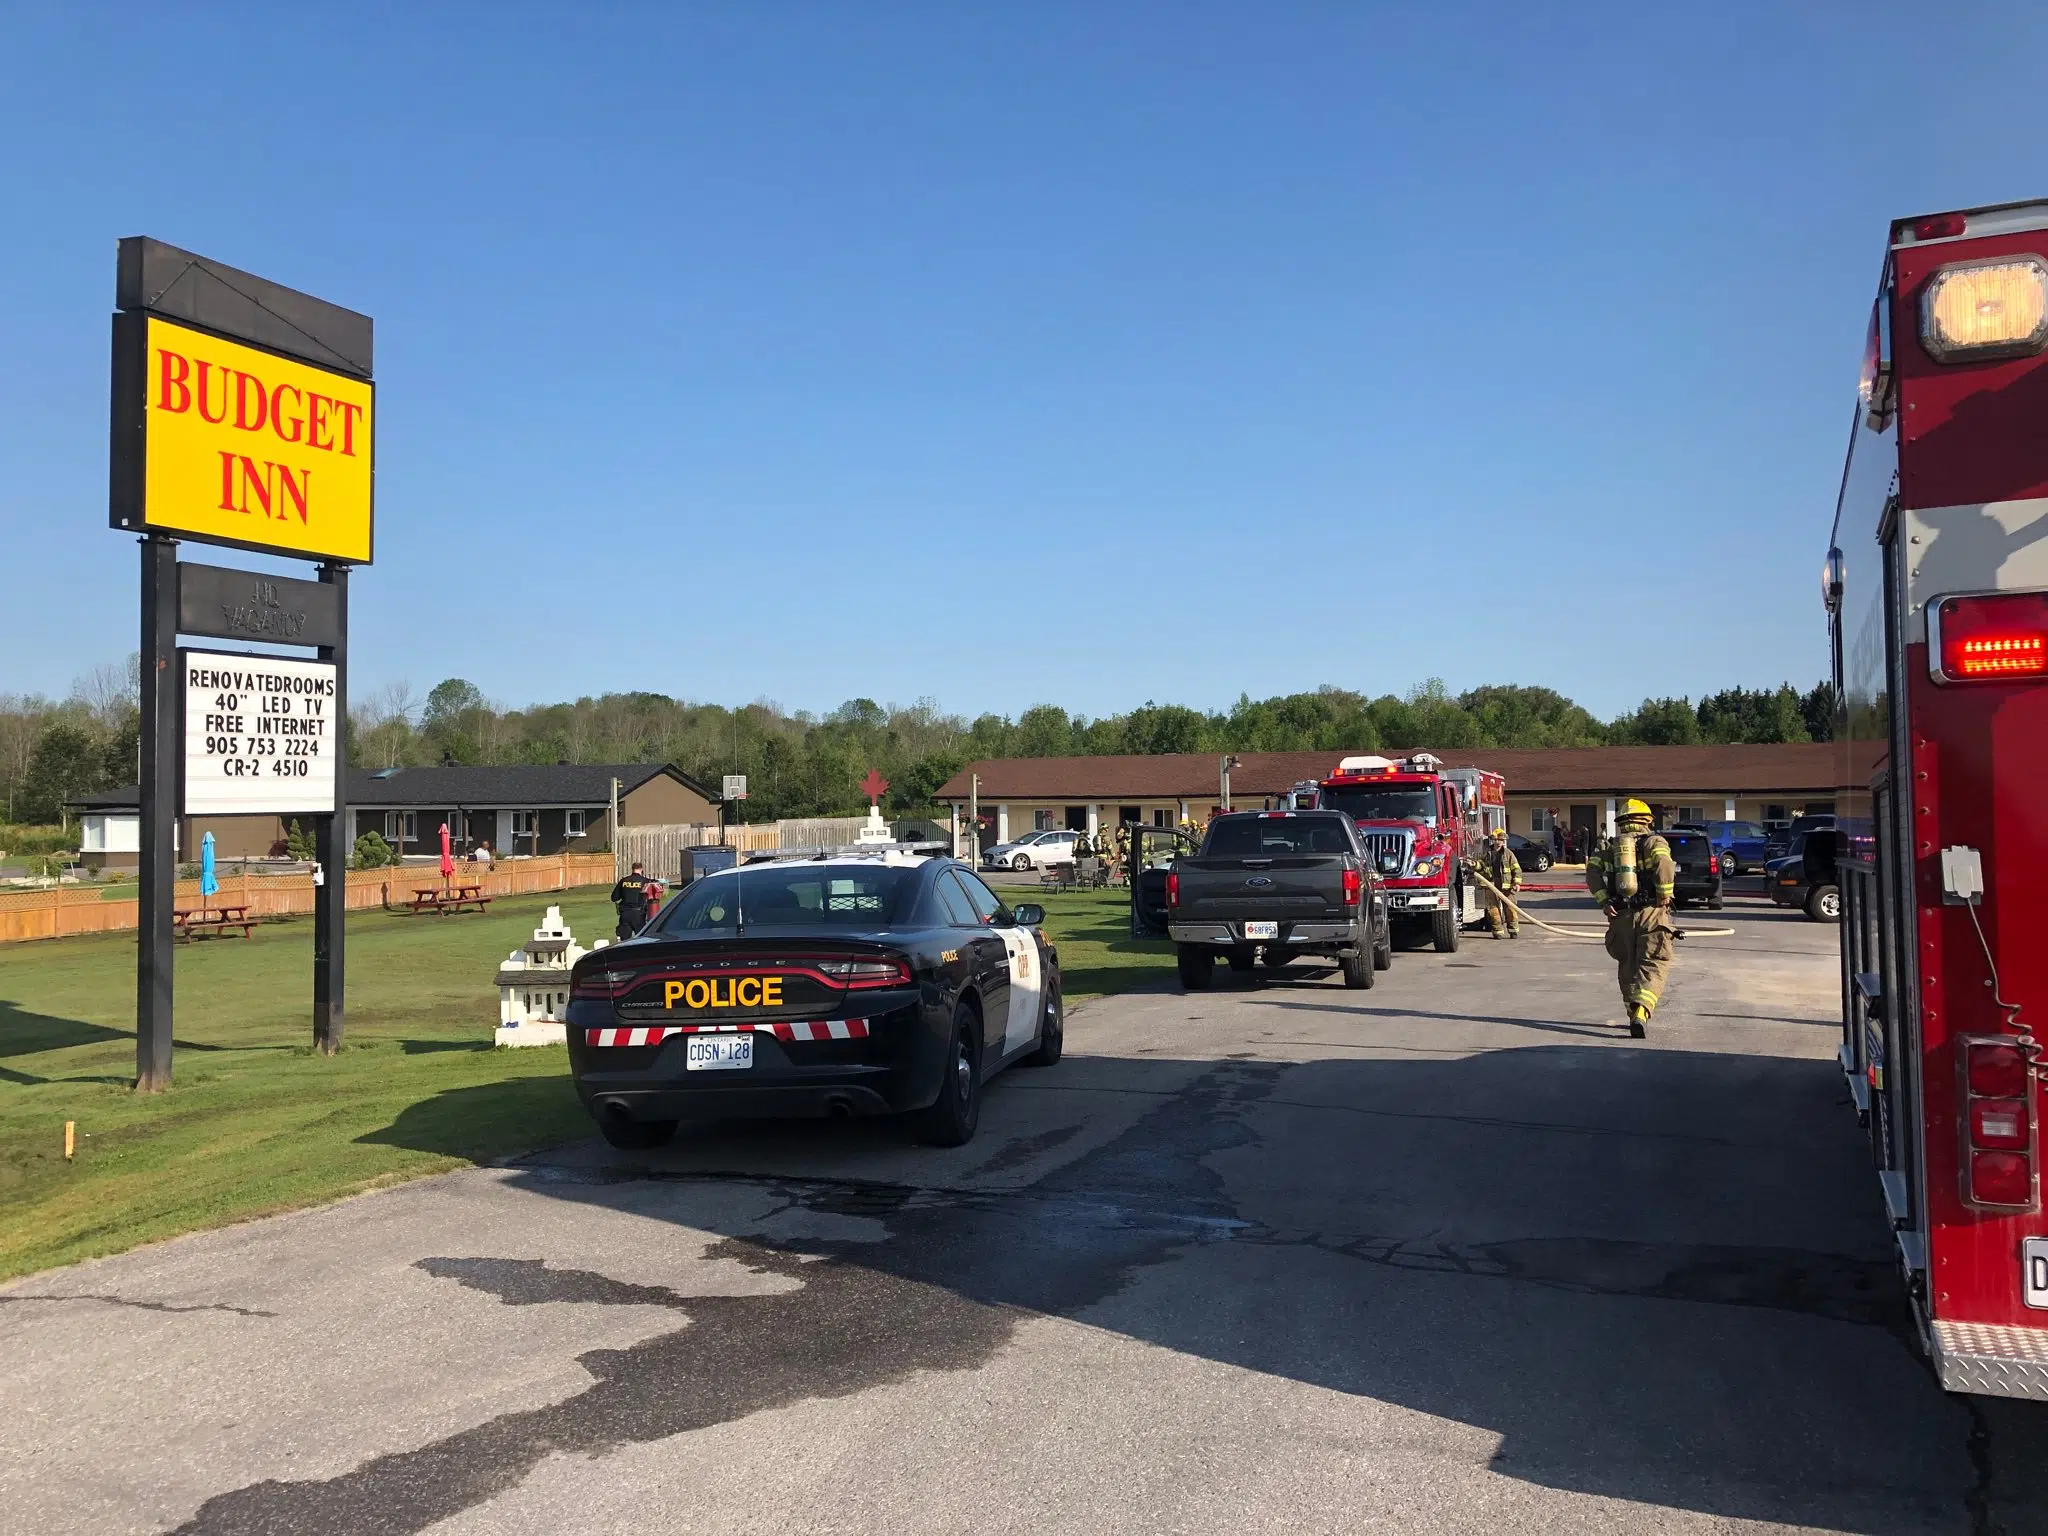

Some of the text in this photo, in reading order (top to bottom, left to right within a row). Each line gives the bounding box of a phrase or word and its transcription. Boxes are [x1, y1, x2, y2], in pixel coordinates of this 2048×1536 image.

[156, 348, 363, 457] BUDGET
[217, 451, 311, 526] INN
[262, 696, 291, 714] LED
[304, 698, 323, 715] TV
[206, 714, 325, 736] FREE INTERNET
[206, 736, 319, 756] 905 753 2224
[223, 759, 308, 776] CR-2 4510
[622, 881, 642, 889] POLICE
[940, 949, 959, 963] POLICE
[665, 977, 784, 1009] POLICE
[690, 1042, 750, 1061] CDSN 128
